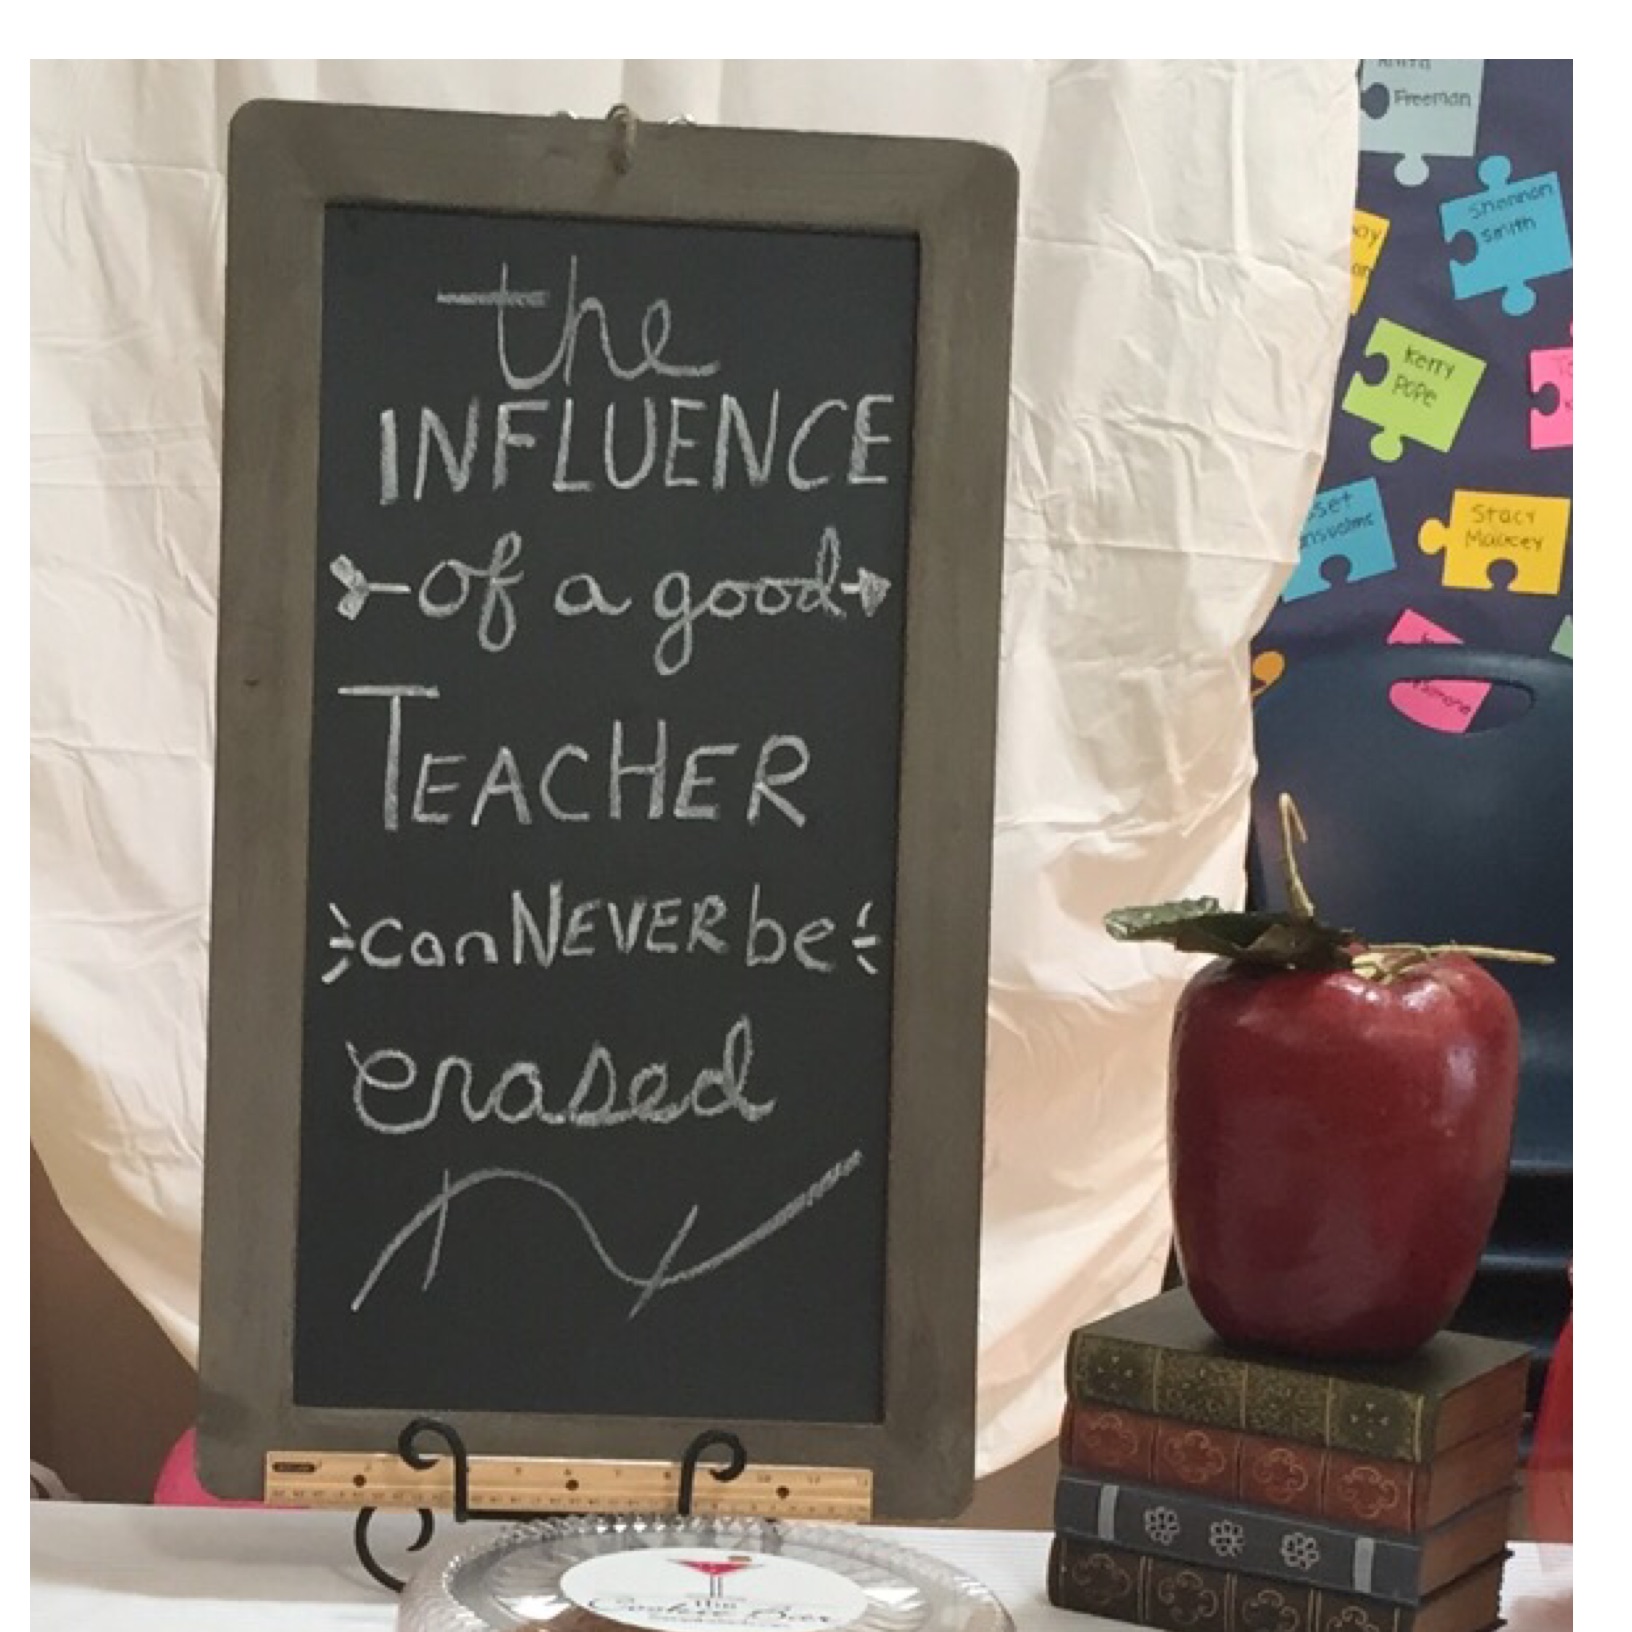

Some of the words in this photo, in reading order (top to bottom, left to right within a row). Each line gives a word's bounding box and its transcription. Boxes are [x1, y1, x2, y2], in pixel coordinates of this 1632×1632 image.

[1394, 90, 1471, 107] Freeman
[1471, 182, 1554, 219] Shannon
[1481, 215, 1537, 244] Smith
[437, 254, 720, 390] the
[1392, 376, 1438, 408] Pope
[1403, 346, 1456, 381] Kerry
[380, 388, 894, 505] INFLUENCE
[1473, 503, 1537, 523] Stacy
[418, 531, 525, 652] of
[554, 573, 632, 616] a
[654, 526, 846, 675] good
[337, 685, 811, 832] TEACHER
[511, 880, 729, 968] NEVER
[746, 883, 836, 972] be
[345, 1014, 775, 1134] erased
